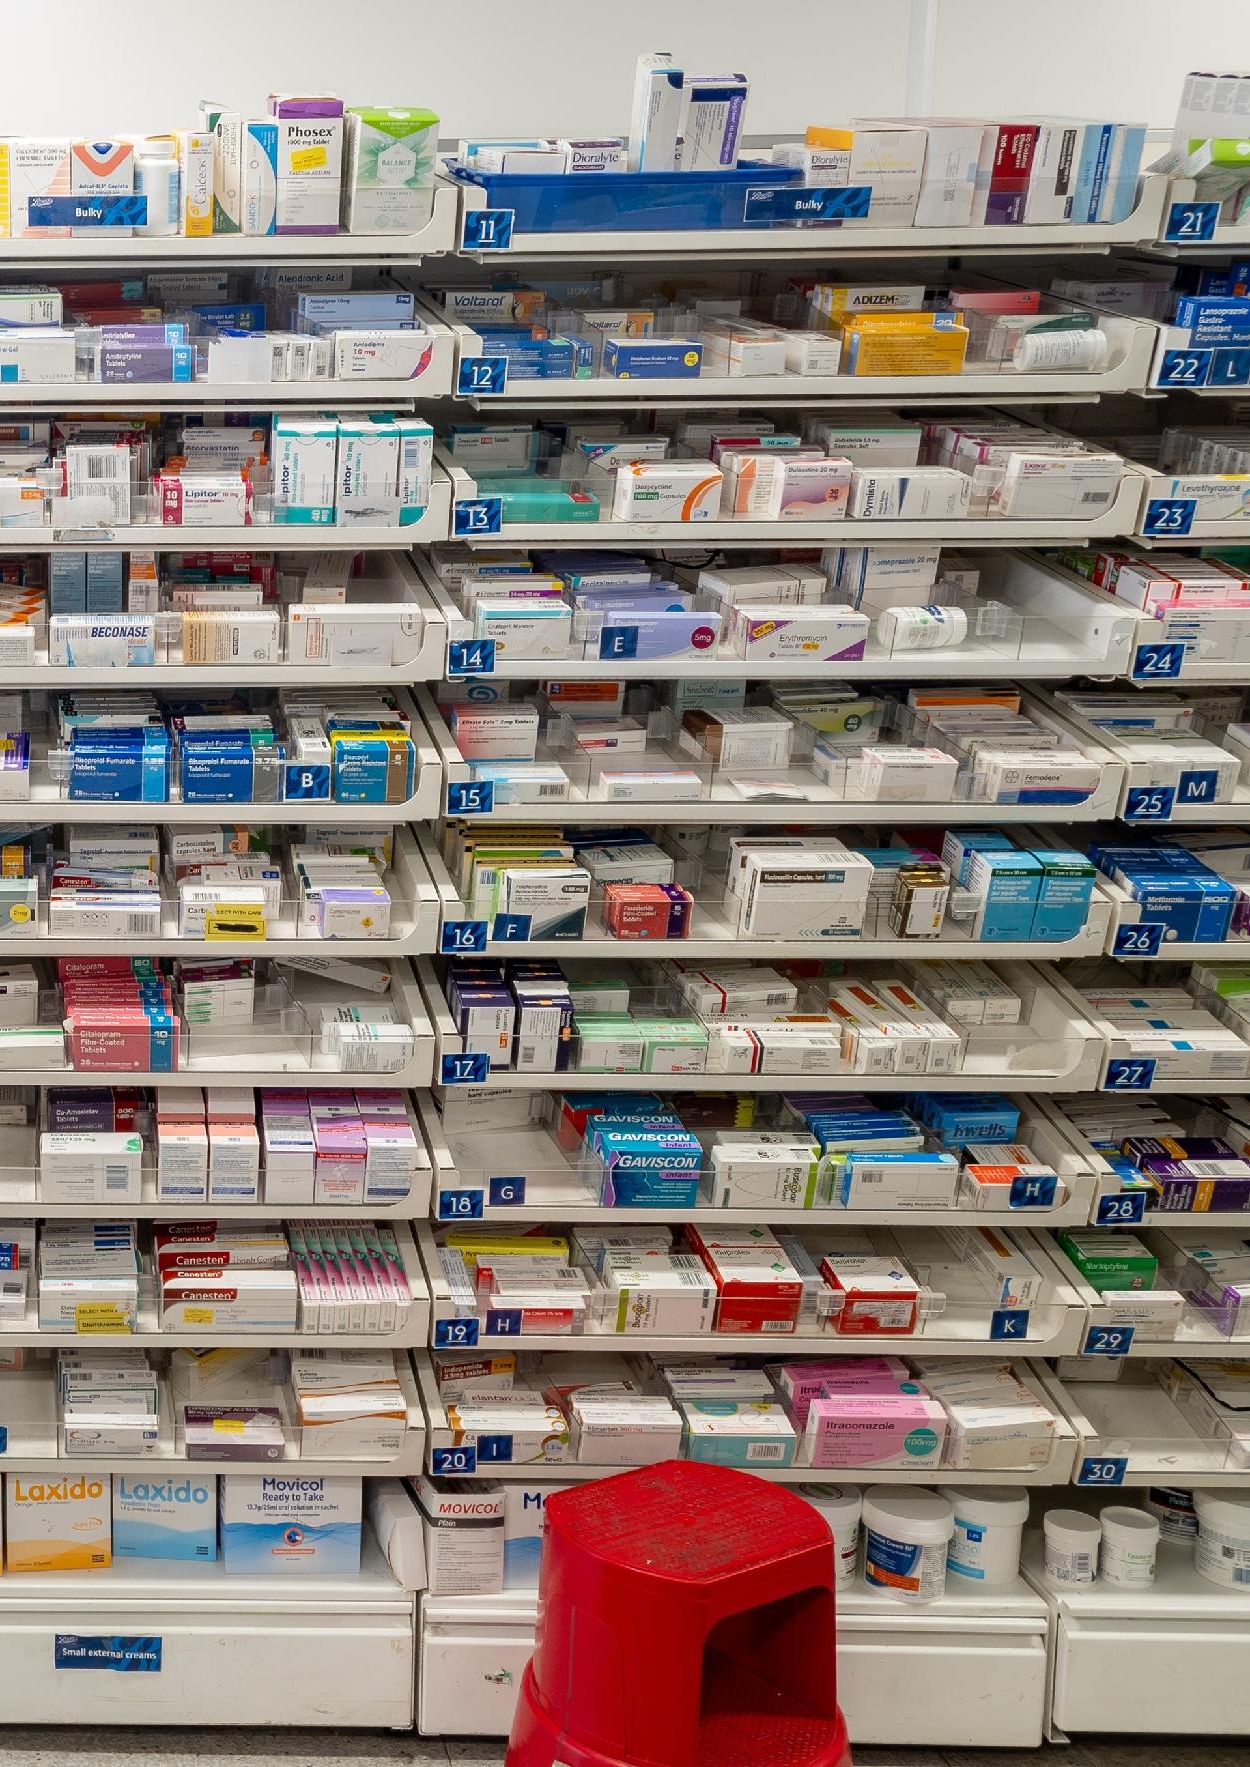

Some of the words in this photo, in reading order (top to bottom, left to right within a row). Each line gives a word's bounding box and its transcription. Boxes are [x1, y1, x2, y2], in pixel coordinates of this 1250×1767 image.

[288, 126, 333, 138] Phosex
[573, 151, 619, 165] Dioralyte
[193, 160, 207, 205] Calceos
[795, 200, 823, 211] Bulky
[76, 208, 102, 219] Bulky
[1180, 211, 1203, 233] 21
[479, 221, 495, 240] 11
[454, 295, 504, 306] Voltarol
[1197, 325, 1232, 333] Resistant
[1169, 359, 1198, 377] 22
[1227, 361, 1236, 377] L
[472, 366, 492, 385] 12
[185, 490, 218, 499] Lipitor
[1182, 483, 1240, 493] Levothyroxine
[166, 491, 178, 500] 10
[863, 479, 875, 517] Dymista
[467, 508, 488, 525] 13
[1155, 508, 1182, 528] 23
[91, 627, 148, 638] BECONASE
[694, 633, 711, 643] 5mg
[614, 637, 623, 652] E
[461, 649, 482, 667] 14
[1144, 653, 1171, 671] 24
[75, 757, 105, 766] Bisoprolol
[107, 757, 135, 765] Fumarate
[188, 757, 219, 766] Bisoprolol
[220, 757, 249, 765] Fumarate
[301, 773, 314, 788] B
[1025, 774, 1061, 783] Femodene
[1187, 782, 1206, 798] M
[461, 790, 480, 806] 15
[1134, 795, 1162, 813] 25
[1147, 896, 1185, 905] Metformin
[1147, 904, 1172, 912] Tablets
[454, 929, 474, 946] 16
[507, 924, 517, 938] F
[1123, 932, 1150, 949] 26
[81, 1030, 121, 1040] Citalopram
[154, 1031, 167, 1039] 10
[81, 1038, 125, 1047] Film-Coated
[81, 1046, 106, 1055] Tablets
[455, 1061, 475, 1078] 17
[1116, 1067, 1142, 1084] 27
[594, 1114, 673, 1123] GAVISCON
[609, 1132, 689, 1142] GAVISCON
[619, 1155, 697, 1168] GAVISCON
[501, 1186, 513, 1200] G
[1026, 1182, 1039, 1196] H
[450, 1197, 470, 1213] 18
[1108, 1202, 1133, 1216] 28
[168, 1225, 213, 1234] Canesten
[171, 1235, 211, 1243] Canesten
[176, 1254, 225, 1265] Canesten
[1086, 1262, 1129, 1273] Nortriptyline
[177, 1271, 221, 1279] Canesten
[182, 1291, 233, 1301] Canesten
[498, 1318, 509, 1332] H
[1004, 1320, 1015, 1333] K
[447, 1326, 466, 1341] 19
[1097, 1334, 1122, 1348] 29
[826, 1421, 895, 1431] Itraconazole
[905, 1438, 937, 1447] 100mg
[442, 1454, 465, 1469] 20
[1088, 1464, 1115, 1479] 30
[15, 1477, 103, 1501] Laxido
[120, 1477, 208, 1504] Laxido
[263, 1477, 324, 1491] Movicol
[263, 1493, 290, 1502] Ready
[292, 1493, 301, 1501] to
[303, 1493, 324, 1501] Take
[439, 1503, 500, 1514] MOVICOL
[62, 1648, 85, 1656] Small
[88, 1650, 123, 1658] external
